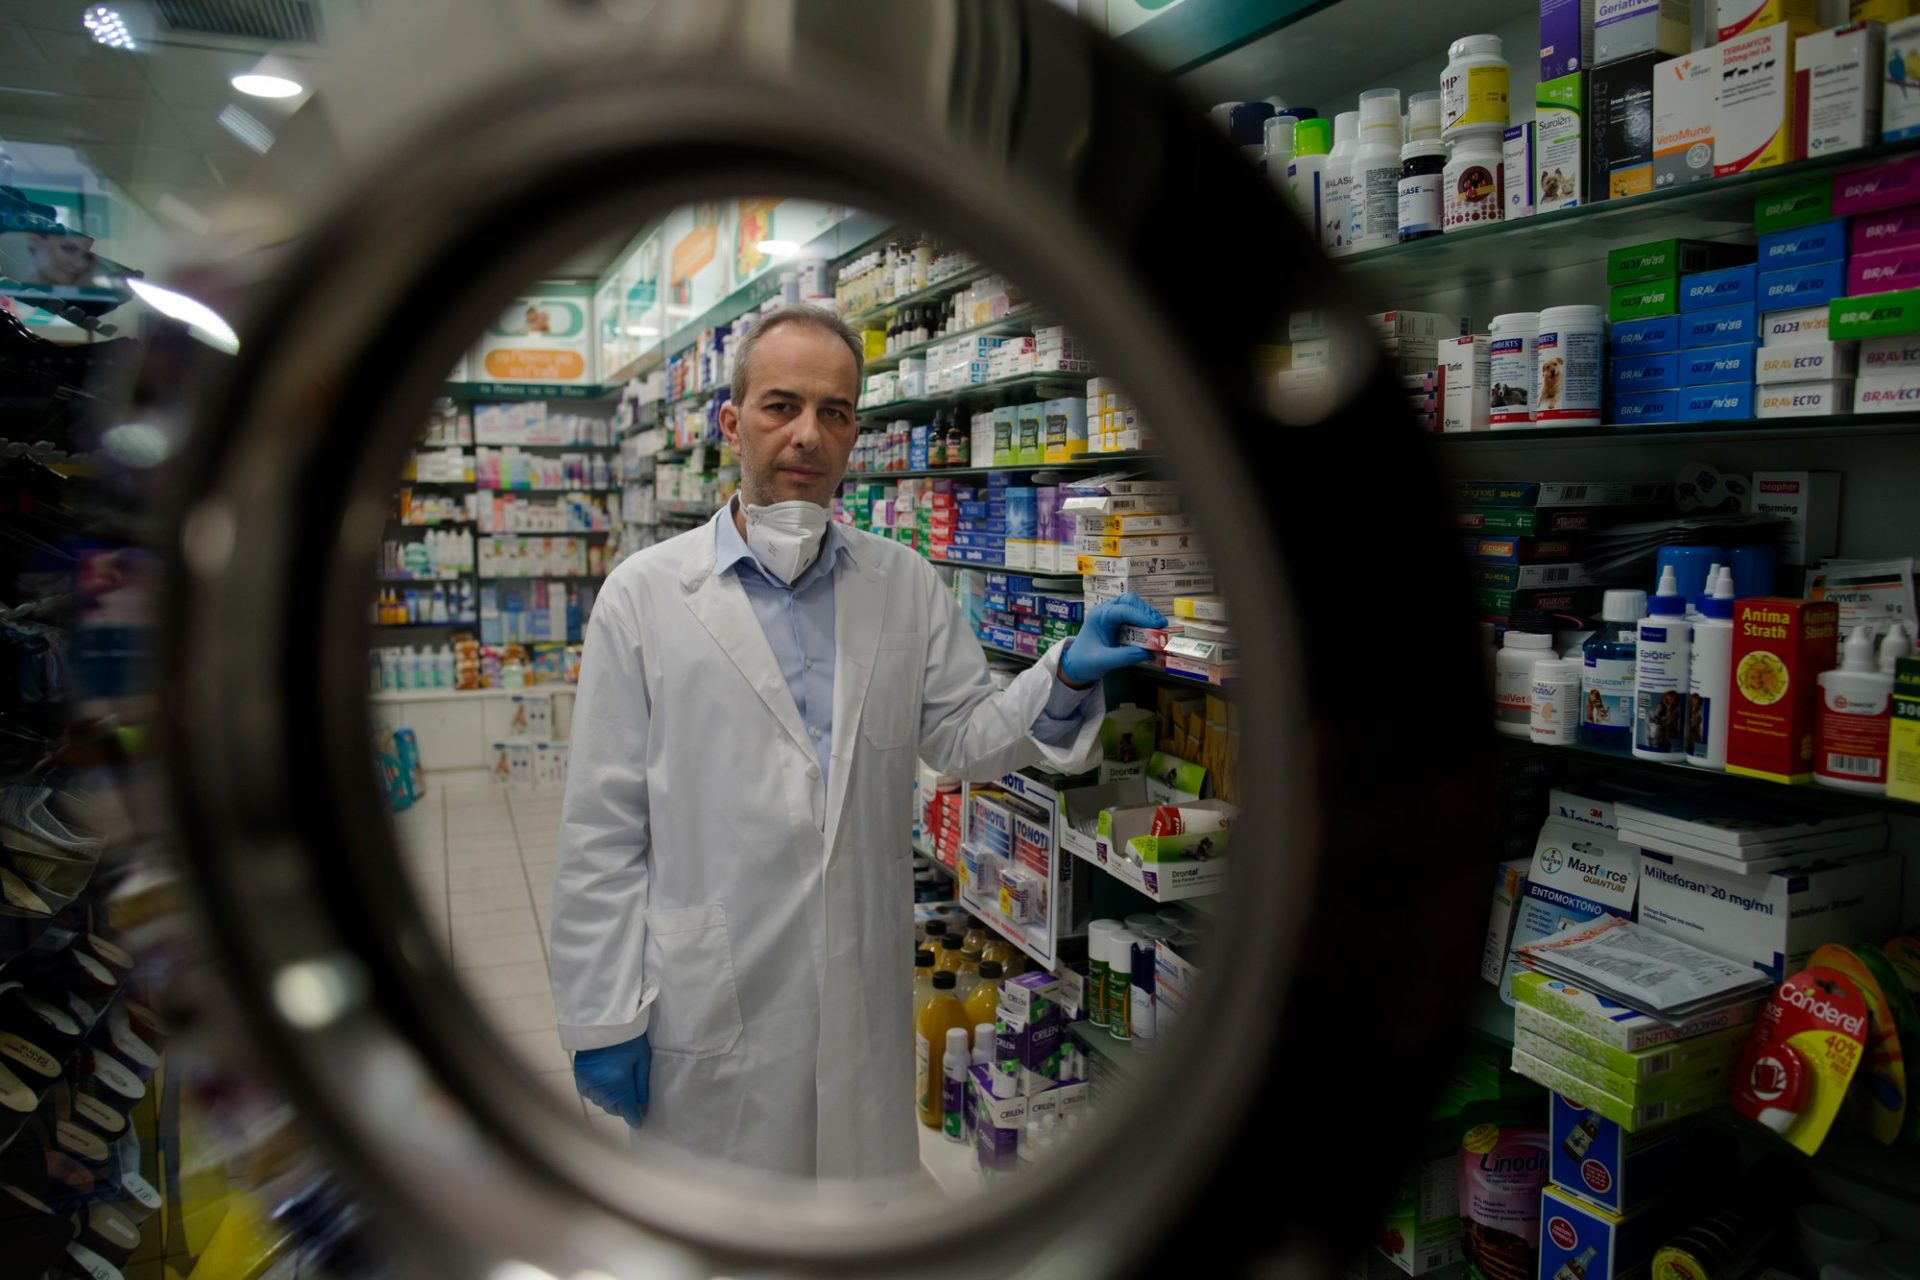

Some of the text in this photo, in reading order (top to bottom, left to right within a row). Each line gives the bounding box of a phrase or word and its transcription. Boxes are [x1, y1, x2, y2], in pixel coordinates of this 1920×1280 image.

[1769, 236, 1825, 256] BRAVECTO
[1690, 279, 1741, 298] BRAVECTO
[1768, 278, 1825, 297] BRAVECTO
[1840, 306, 1902, 324] BRAVECTO
[1620, 329, 1665, 344] BRAVECTO
[1764, 355, 1823, 371] BRAVECTO
[1867, 349, 1920, 364] BRAVEC
[1620, 366, 1664, 381] BRAVECTO
[1763, 394, 1822, 409] BRAVECTO
[1863, 387, 1920, 403] BRAVECT
[1620, 403, 1664, 416] BRAVECTO
[1761, 482, 1798, 493] beaphar
[1758, 503, 1798, 515] Worming
[1742, 608, 1791, 625] Anima
[1803, 607, 1837, 624] Anima
[1743, 622, 1788, 640] Strath
[1109, 767, 1141, 777] Drontal
[975, 801, 1007, 831] TONOTIL
[1590, 808, 1603, 819] 3M
[1016, 820, 1049, 849] TONOTI
[1172, 868, 1199, 879] Drontal
[1583, 875, 1626, 893] QUANTUM
[1644, 864, 1773, 916] Milteforan 20 mg/ml
[1007, 994, 1027, 1007] CRILEN
[1779, 982, 1864, 1037] Canderel
[1032, 1024, 1059, 1043] CRILEN
[1824, 1035, 1857, 1060] 40%
[1000, 1108, 1025, 1119] CRILEN
[1032, 1102, 1056, 1113] CRILEN
